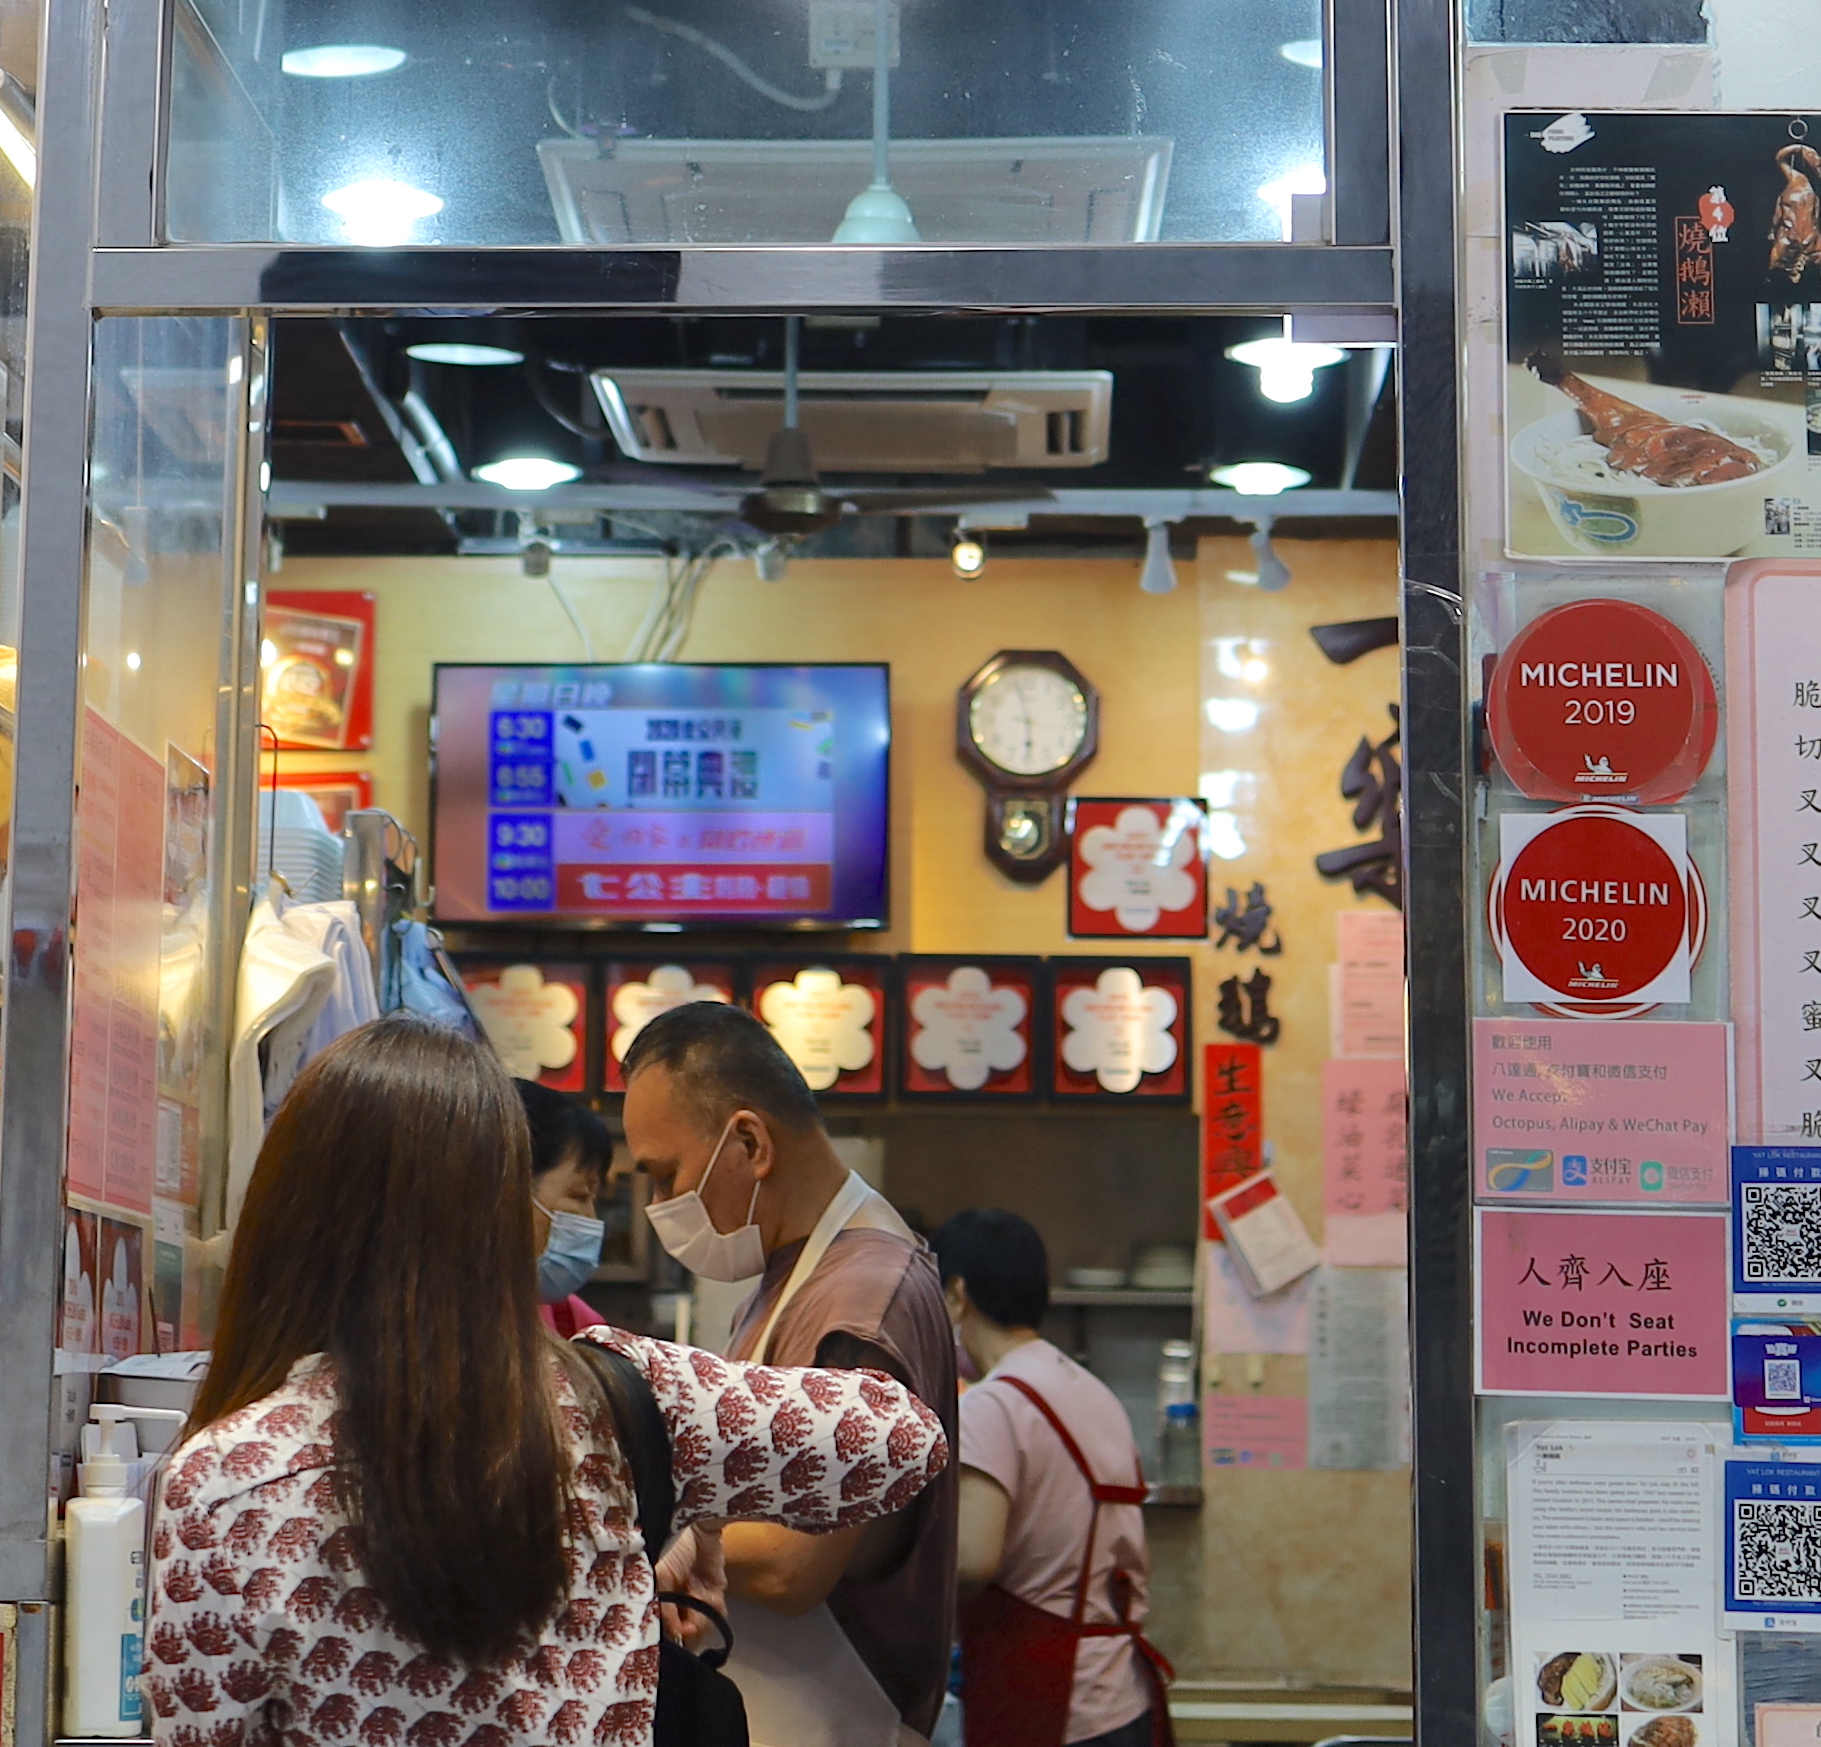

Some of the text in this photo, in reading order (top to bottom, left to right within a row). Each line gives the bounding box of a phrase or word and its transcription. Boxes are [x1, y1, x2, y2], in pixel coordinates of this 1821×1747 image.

[1678, 222, 1711, 319] 燒鵝瀨
[1520, 662, 1679, 688] MICHELIN
[1564, 700, 1636, 726] 2019
[1519, 878, 1670, 906] MICHELIN
[1561, 917, 1627, 942] 2020
[1493, 1116, 1708, 1134] Octopus, Alipay WeChat Pay
[1517, 1254, 1673, 1293] 人齊入座
[1523, 1311, 1675, 1331] We Don't Seat
[1506, 1337, 1698, 1359] Incomplete Parties
